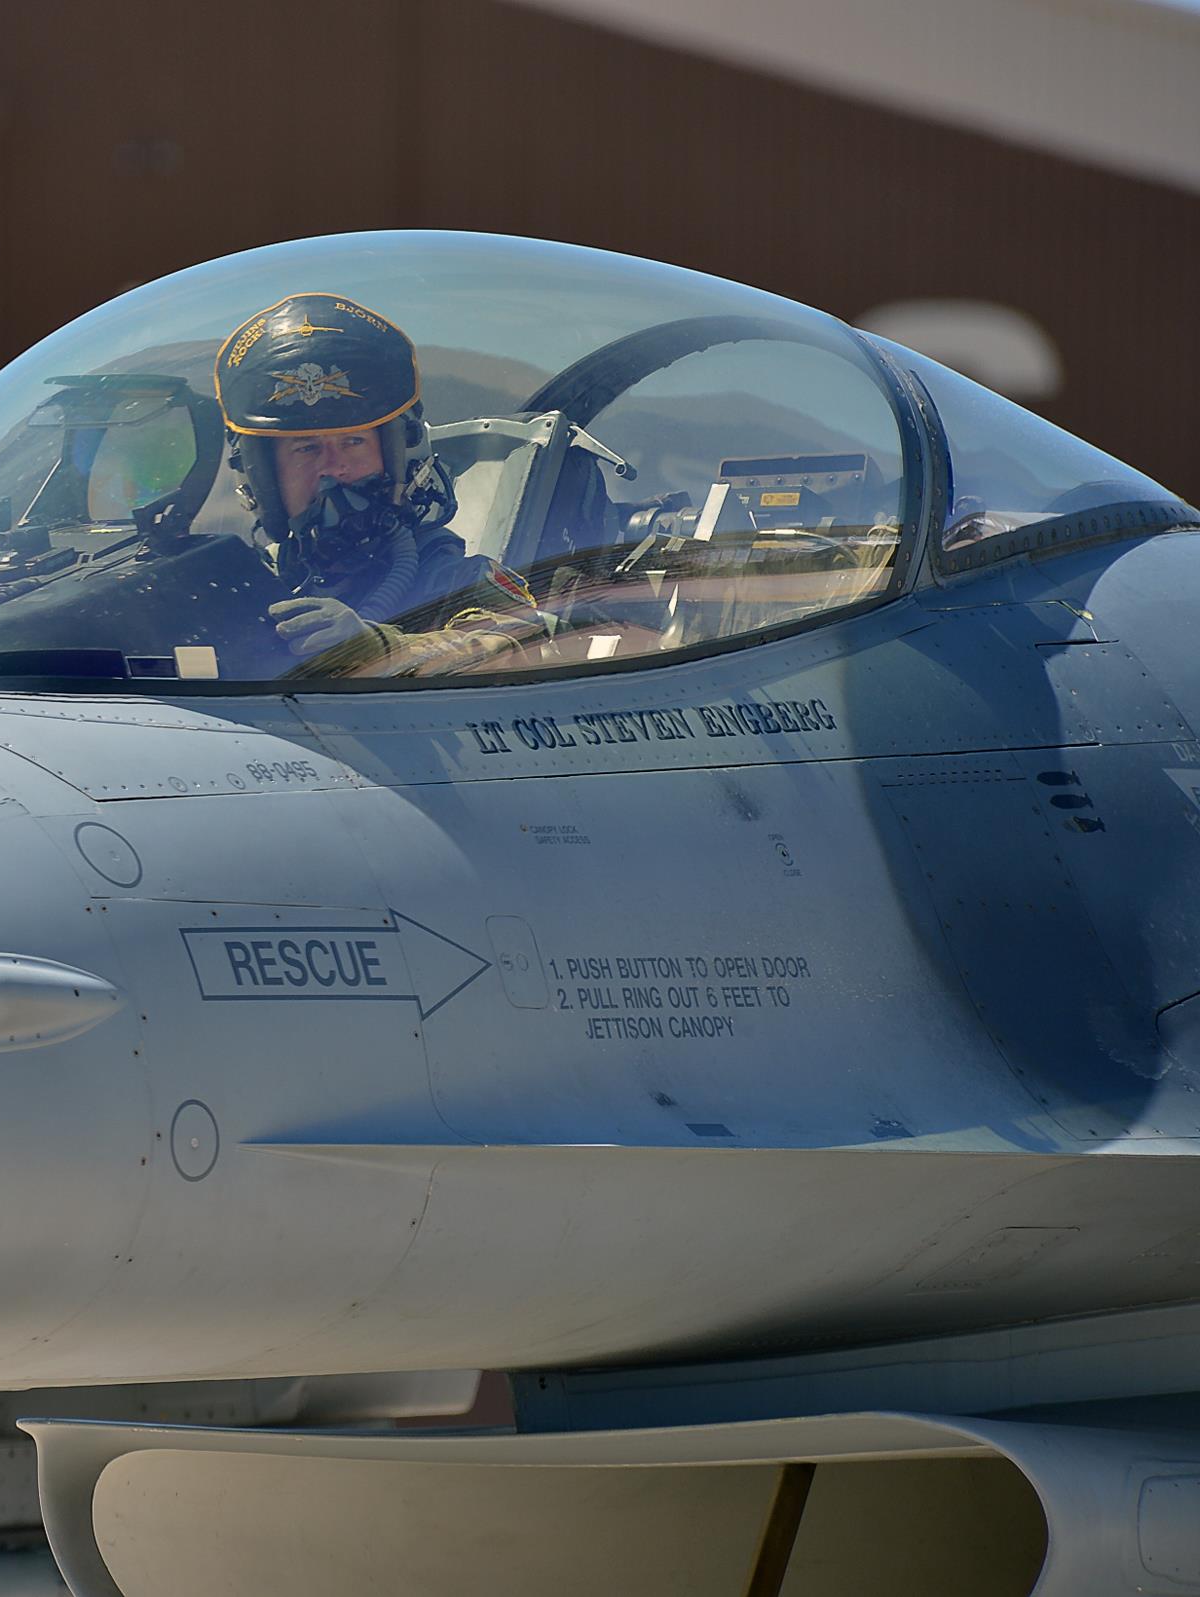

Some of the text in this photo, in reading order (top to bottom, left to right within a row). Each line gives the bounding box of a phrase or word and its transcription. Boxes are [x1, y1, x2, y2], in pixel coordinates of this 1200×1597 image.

[466, 699, 838, 755] LT COL STEVEN ENGBERG
[246, 760, 318, 781] 88-0495
[224, 939, 388, 987] RESCUE
[549, 957, 811, 980] 1. PUSH BUTTON TO OPEN DOOR
[557, 986, 791, 1010] 2. PULL RING OUT 6 FEET TO
[585, 1015, 735, 1040] JETTISON CANOPY
